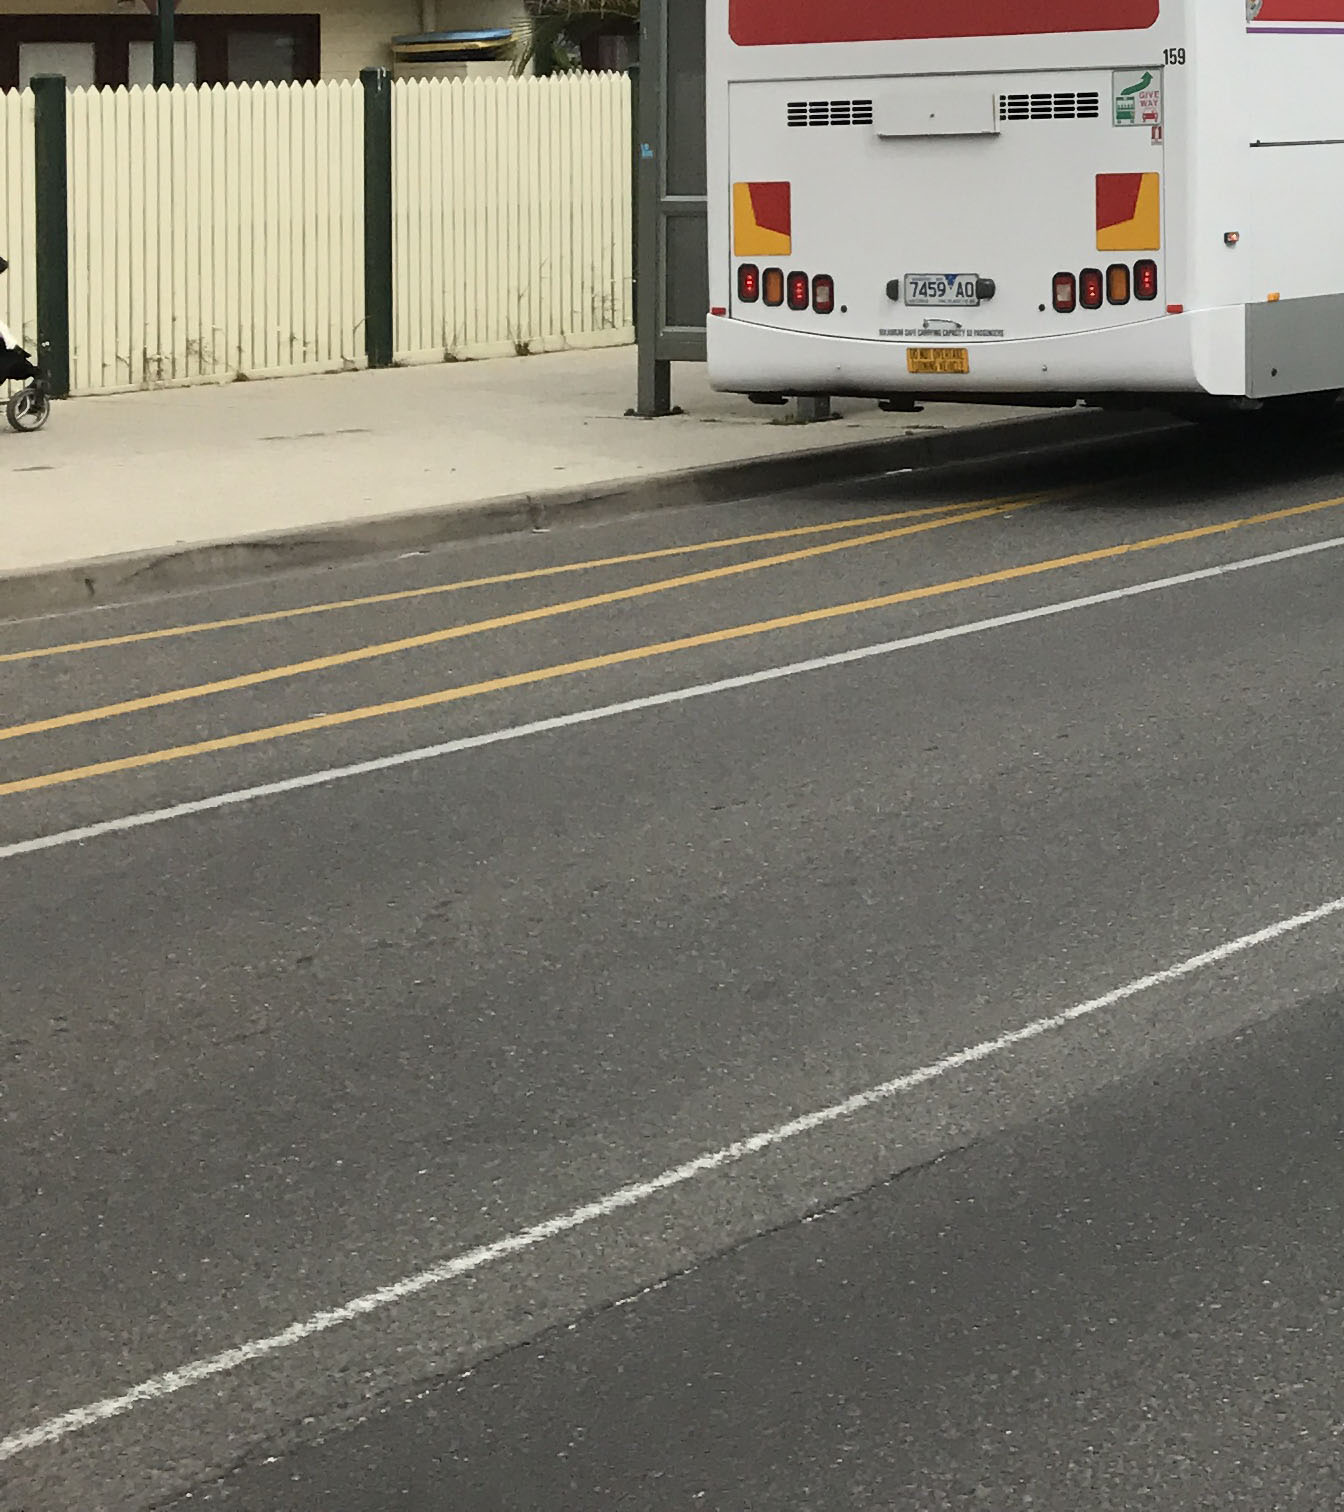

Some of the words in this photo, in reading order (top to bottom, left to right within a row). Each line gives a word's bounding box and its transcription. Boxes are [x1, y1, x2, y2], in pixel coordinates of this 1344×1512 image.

[1163, 47, 1186, 65] 159
[1139, 90, 1160, 100] GIVE
[1140, 99, 1159, 108] WAY
[909, 282, 946, 298] 7459
